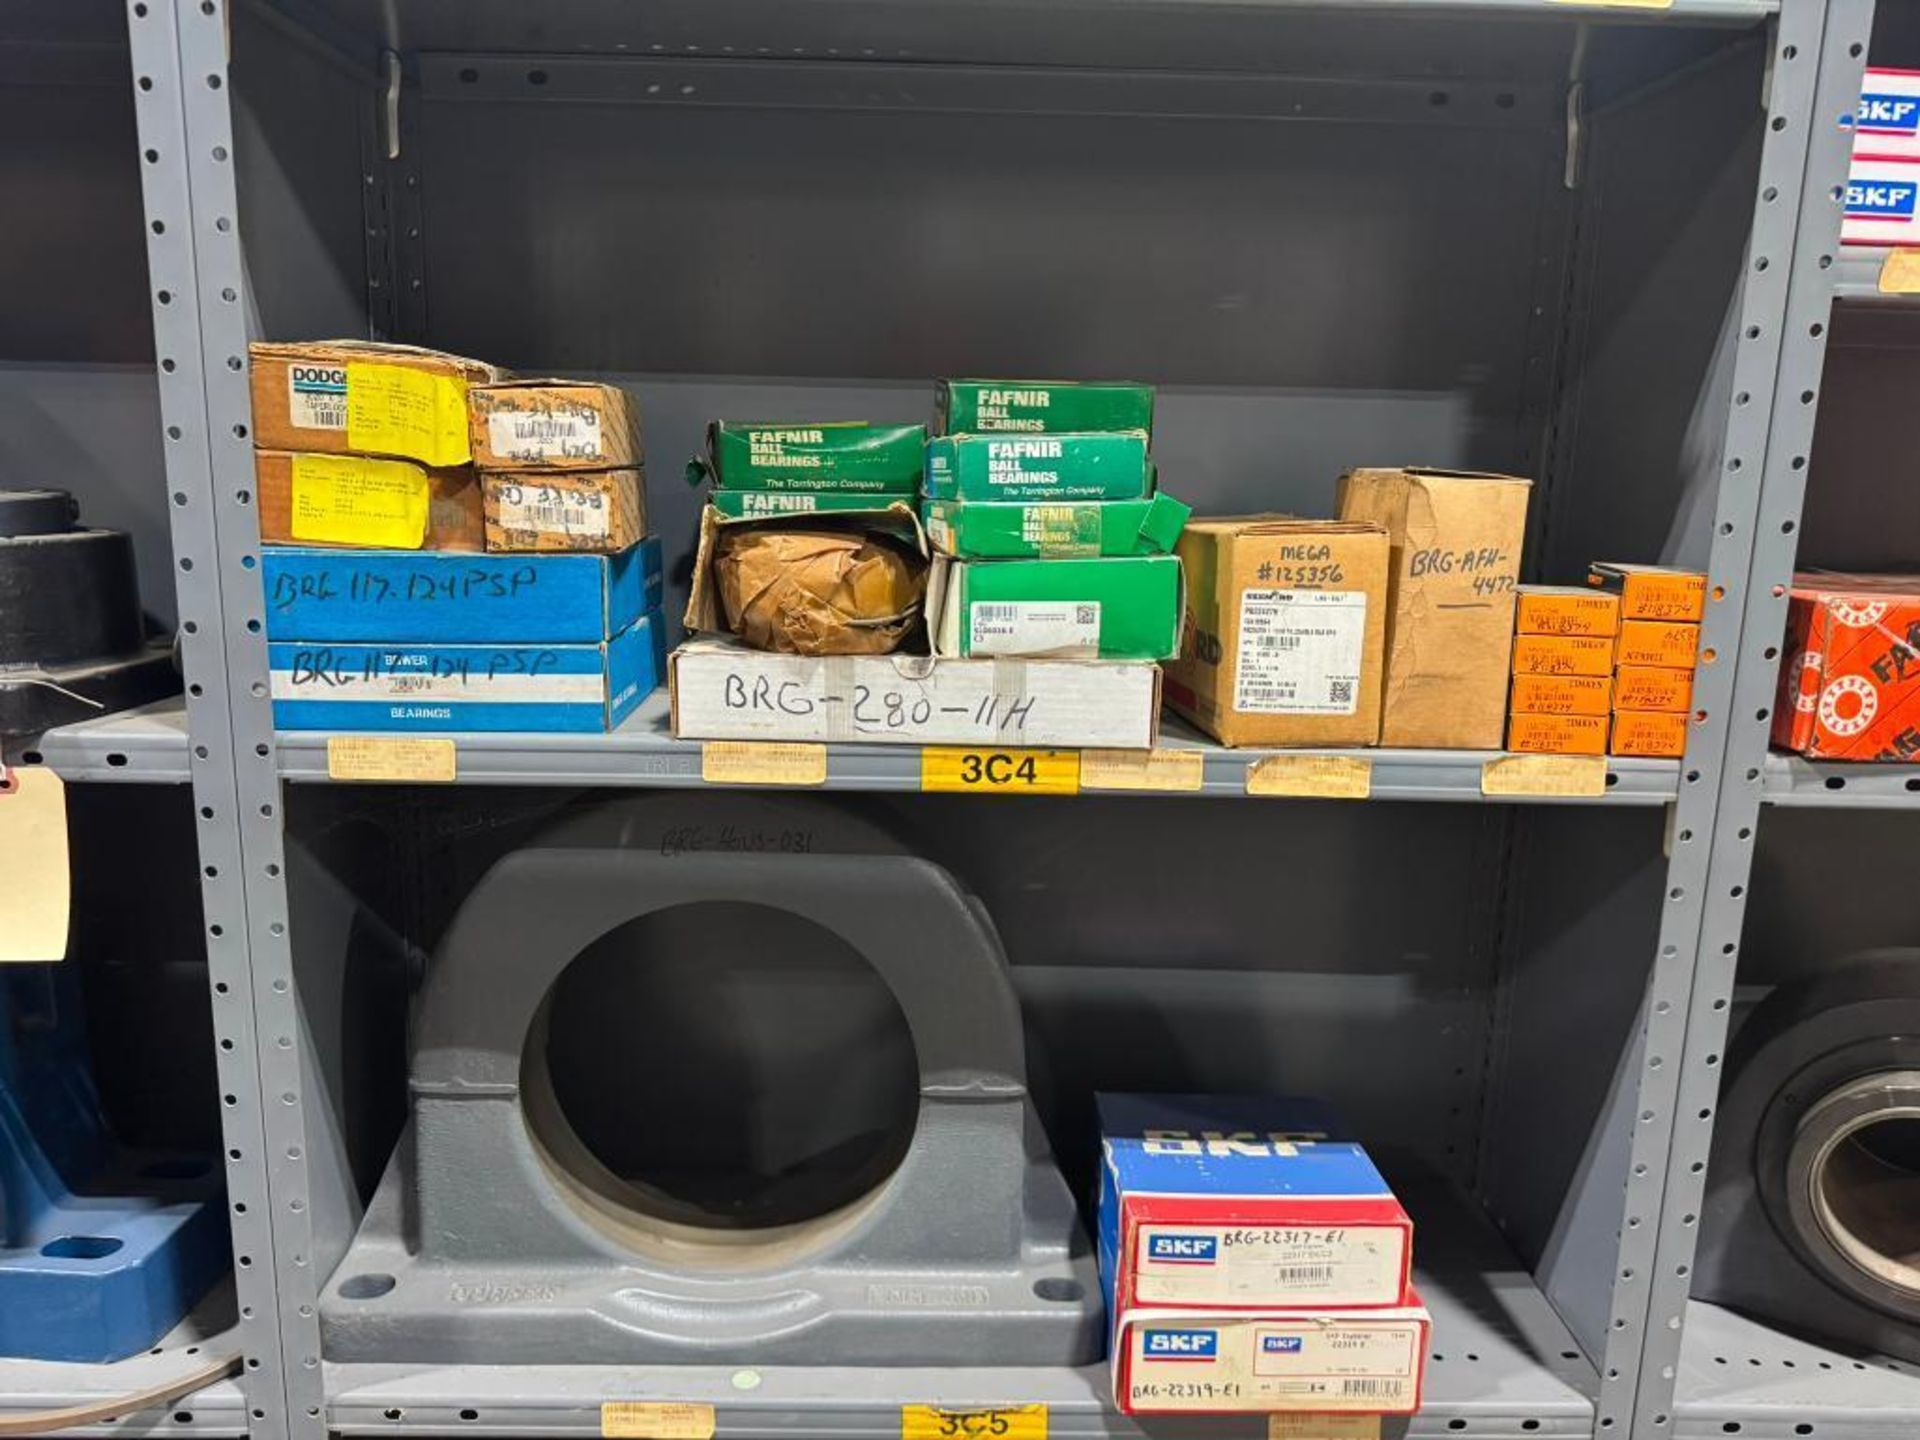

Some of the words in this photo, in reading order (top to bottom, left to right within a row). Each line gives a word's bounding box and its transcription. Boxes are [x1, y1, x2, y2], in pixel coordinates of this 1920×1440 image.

[1846, 186, 1912, 206] SKF
[293, 368, 347, 383] DODG
[978, 390, 1050, 407] FAFNIR
[978, 407, 1009, 419] BALL
[977, 420, 1045, 431] BEARINGS
[749, 430, 823, 444] FAFNIR
[751, 444, 784, 454] BALL
[988, 442, 1062, 459] FAFNIR
[751, 455, 820, 467] BEARINGS
[989, 460, 1021, 472] BALL
[766, 479, 784, 488] The
[839, 479, 885, 490] Company
[988, 472, 1058, 484] BEARINGS
[1003, 487, 1019, 496] The
[1066, 487, 1105, 498] Company
[742, 494, 815, 511] FAFNIR
[1023, 507, 1074, 521] FAFNIR
[1023, 522, 1044, 531] BALL
[1023, 531, 1071, 542] BEARINGS
[1280, 545, 1331, 560] MEGA
[1256, 564, 1344, 583] #125356
[390, 708, 450, 719] BEARINGS
[960, 754, 1037, 785] 3C4
[1223, 1230, 1345, 1247] BRG-22317-E1
[1154, 1238, 1212, 1254] SKF
[1149, 1335, 1212, 1350] SKF
[1266, 1338, 1300, 1348] SKF
[1132, 1384, 1241, 1399] BRG-22319-E1
[938, 1410, 1009, 1435] 3C5
